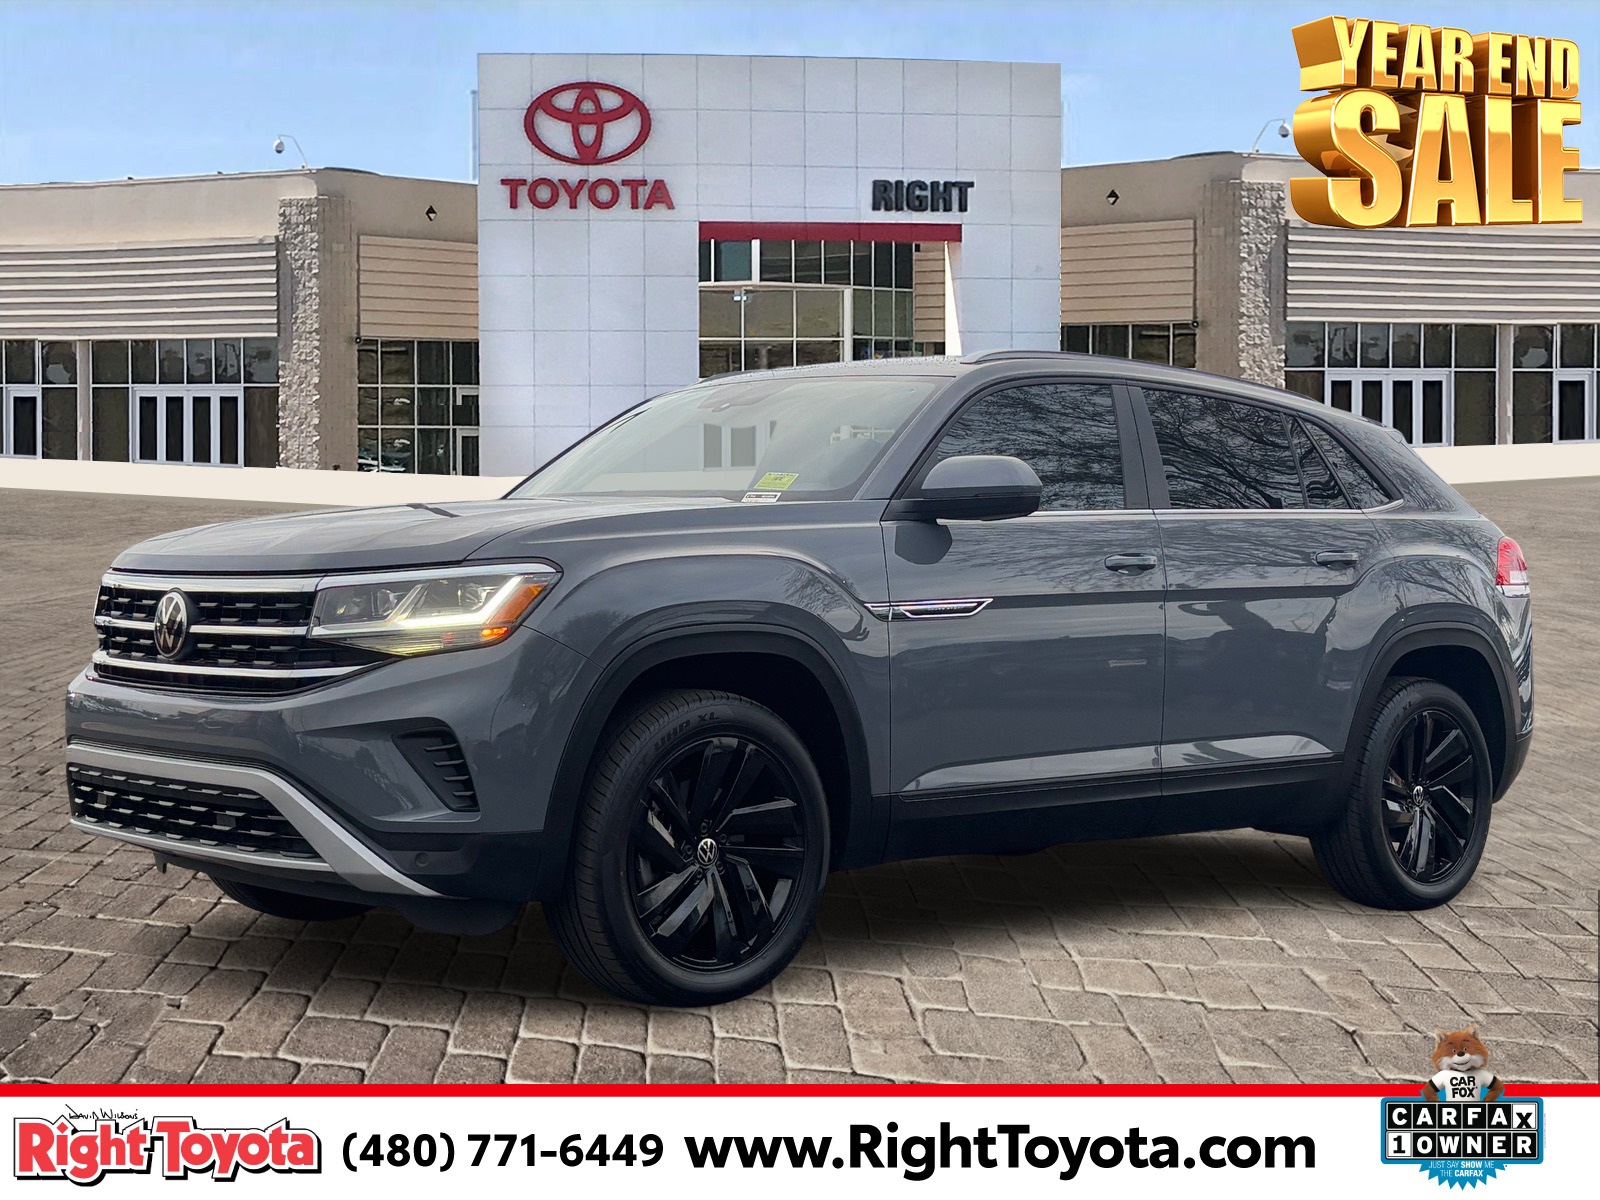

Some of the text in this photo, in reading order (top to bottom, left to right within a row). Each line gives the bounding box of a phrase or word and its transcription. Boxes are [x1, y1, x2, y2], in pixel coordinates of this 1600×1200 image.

[501, 178, 675, 210] TOYOTA
[871, 179, 975, 212] RIGHT
[698, 711, 720, 722] XL
